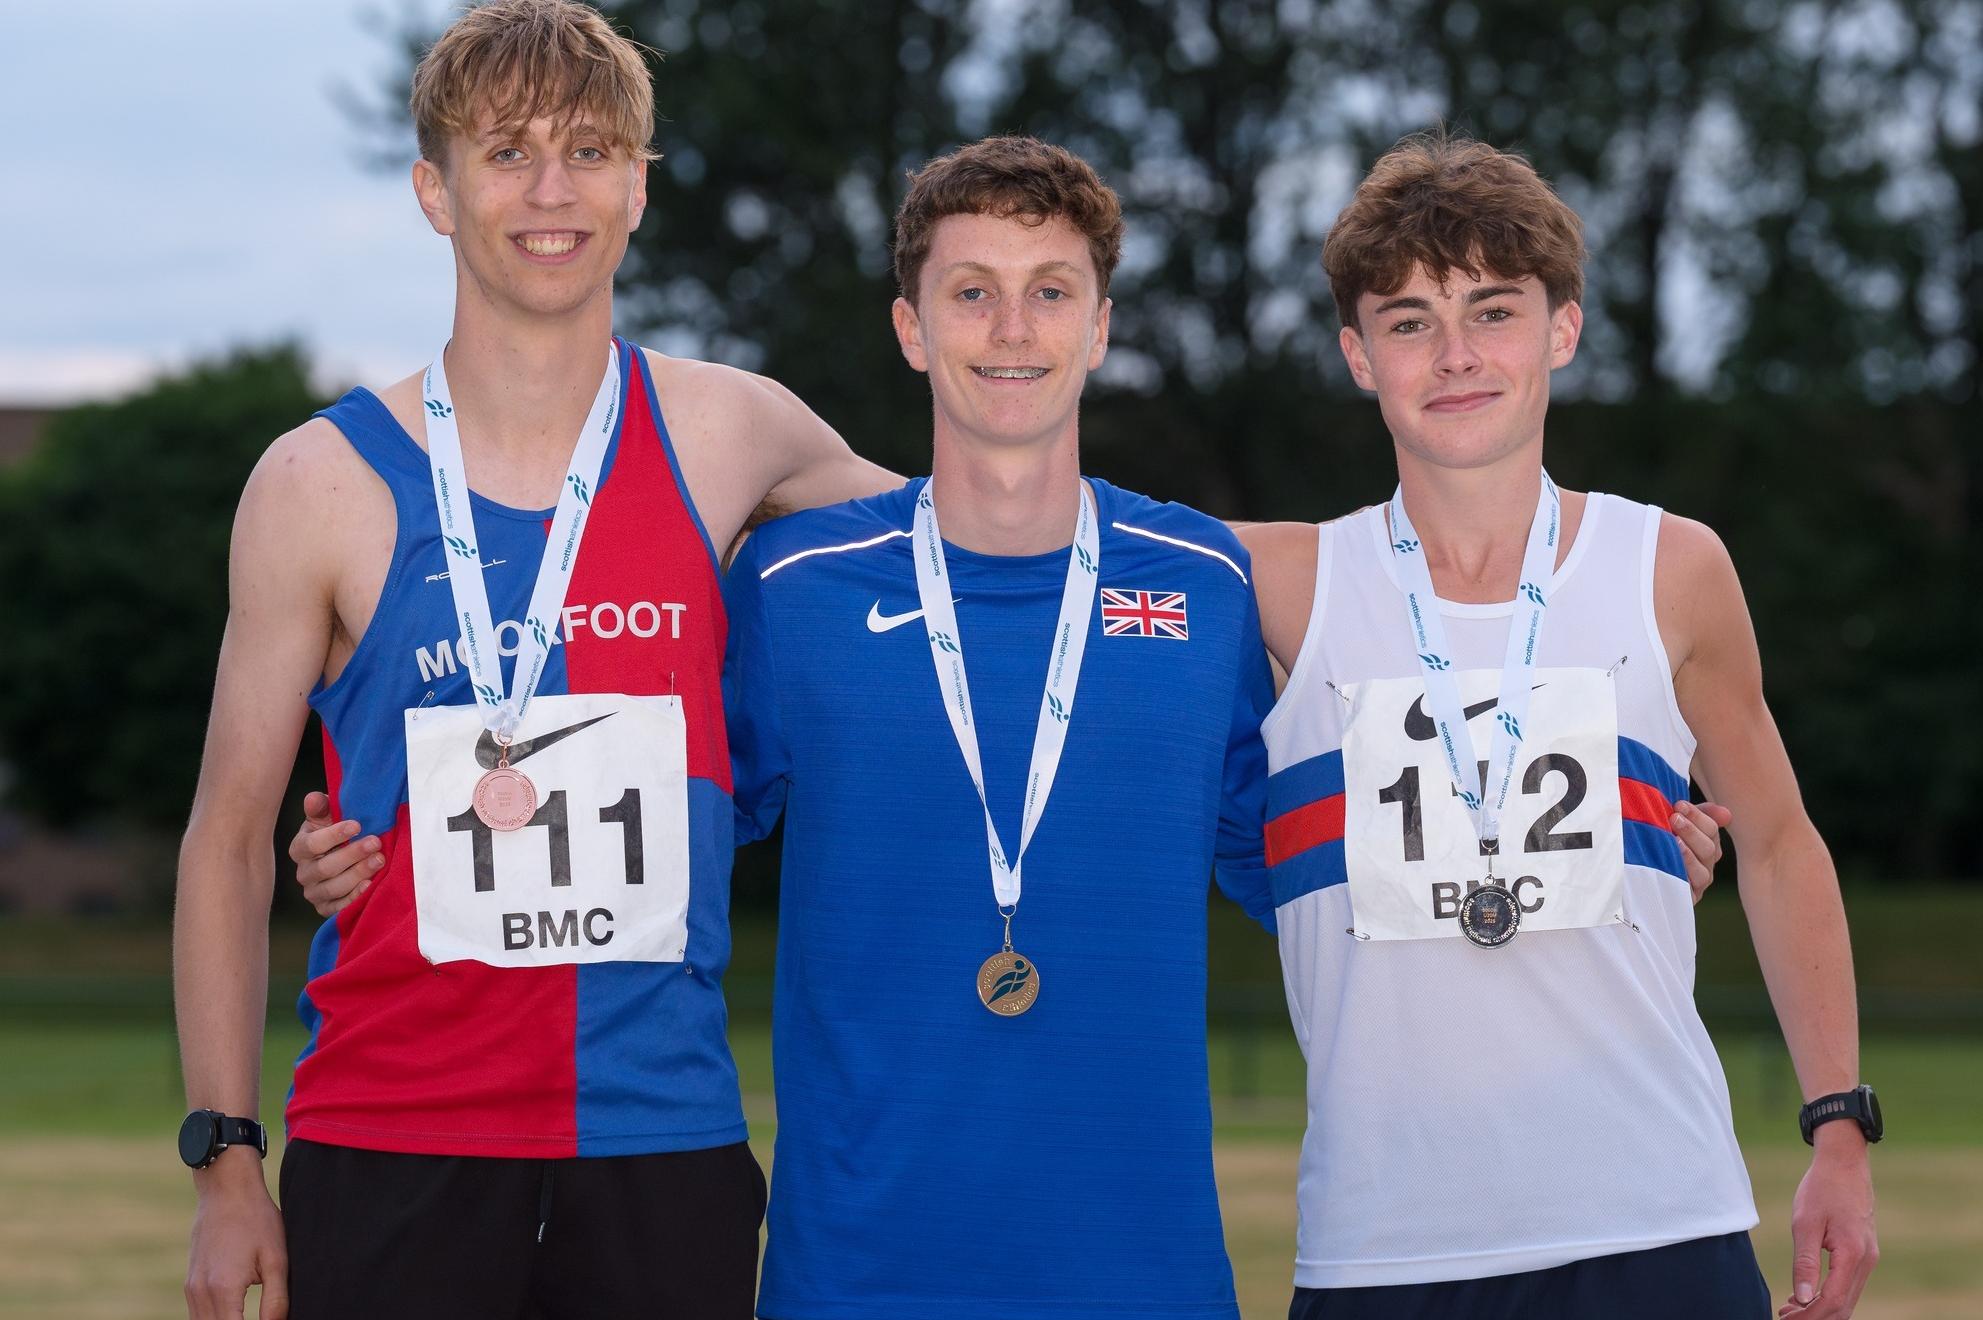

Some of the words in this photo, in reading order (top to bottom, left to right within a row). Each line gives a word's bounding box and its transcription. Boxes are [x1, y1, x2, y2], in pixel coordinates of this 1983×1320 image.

[415, 601, 687, 683] MOFOOT
[447, 788, 644, 892] 111
[502, 907, 614, 951] BMC
[1431, 875, 1545, 920] BC
